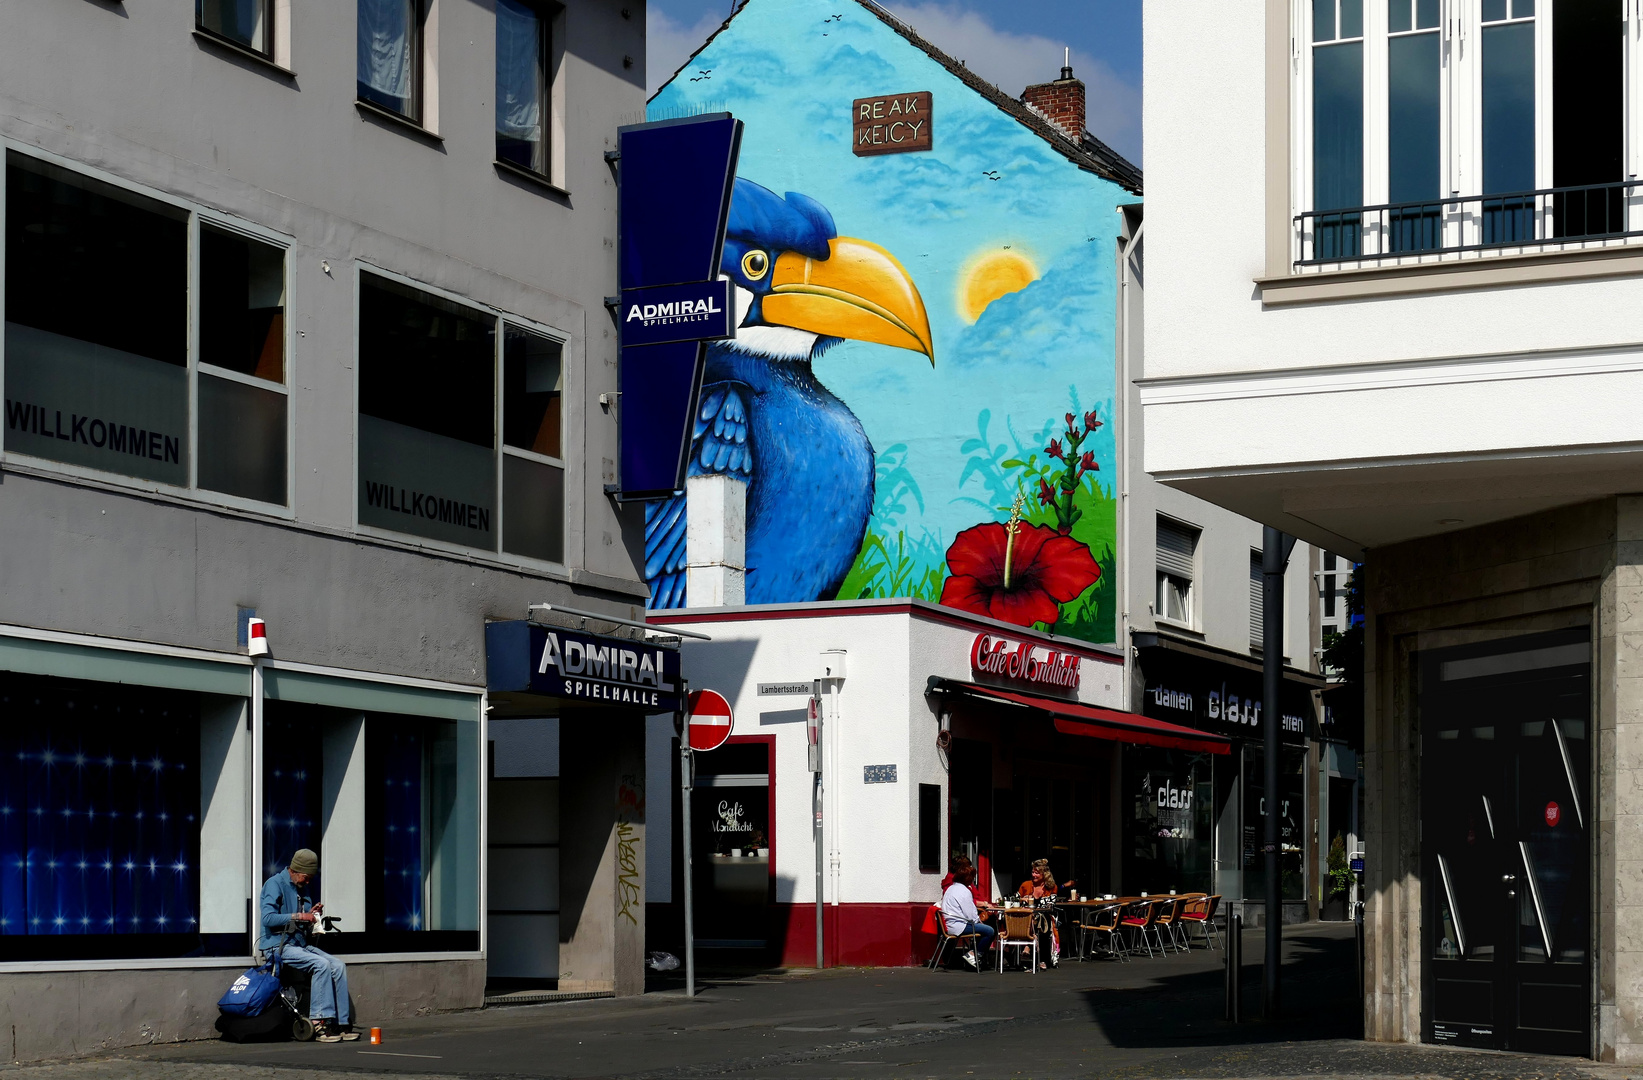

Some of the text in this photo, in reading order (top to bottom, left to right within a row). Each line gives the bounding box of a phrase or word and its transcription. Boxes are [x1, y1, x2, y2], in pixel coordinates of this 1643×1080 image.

[860, 97, 918, 120] REAK
[858, 119, 924, 145] KEICY
[626, 296, 721, 322] ADMIRAL
[643, 313, 709, 326] SPIELHALLE
[7, 399, 179, 464] WILLKOMMEN
[366, 480, 489, 531] WILLKOMMEN
[538, 632, 674, 692] ADMIRAL
[1008, 643, 1081, 688] Mondlicht
[565, 680, 658, 706] SPIELHALLE
[761, 684, 809, 694] Lambertsstraße
[1155, 683, 1192, 711] damen
[1208, 680, 1261, 727] class
[1158, 779, 1193, 809] class
[718, 800, 744, 821] Café
